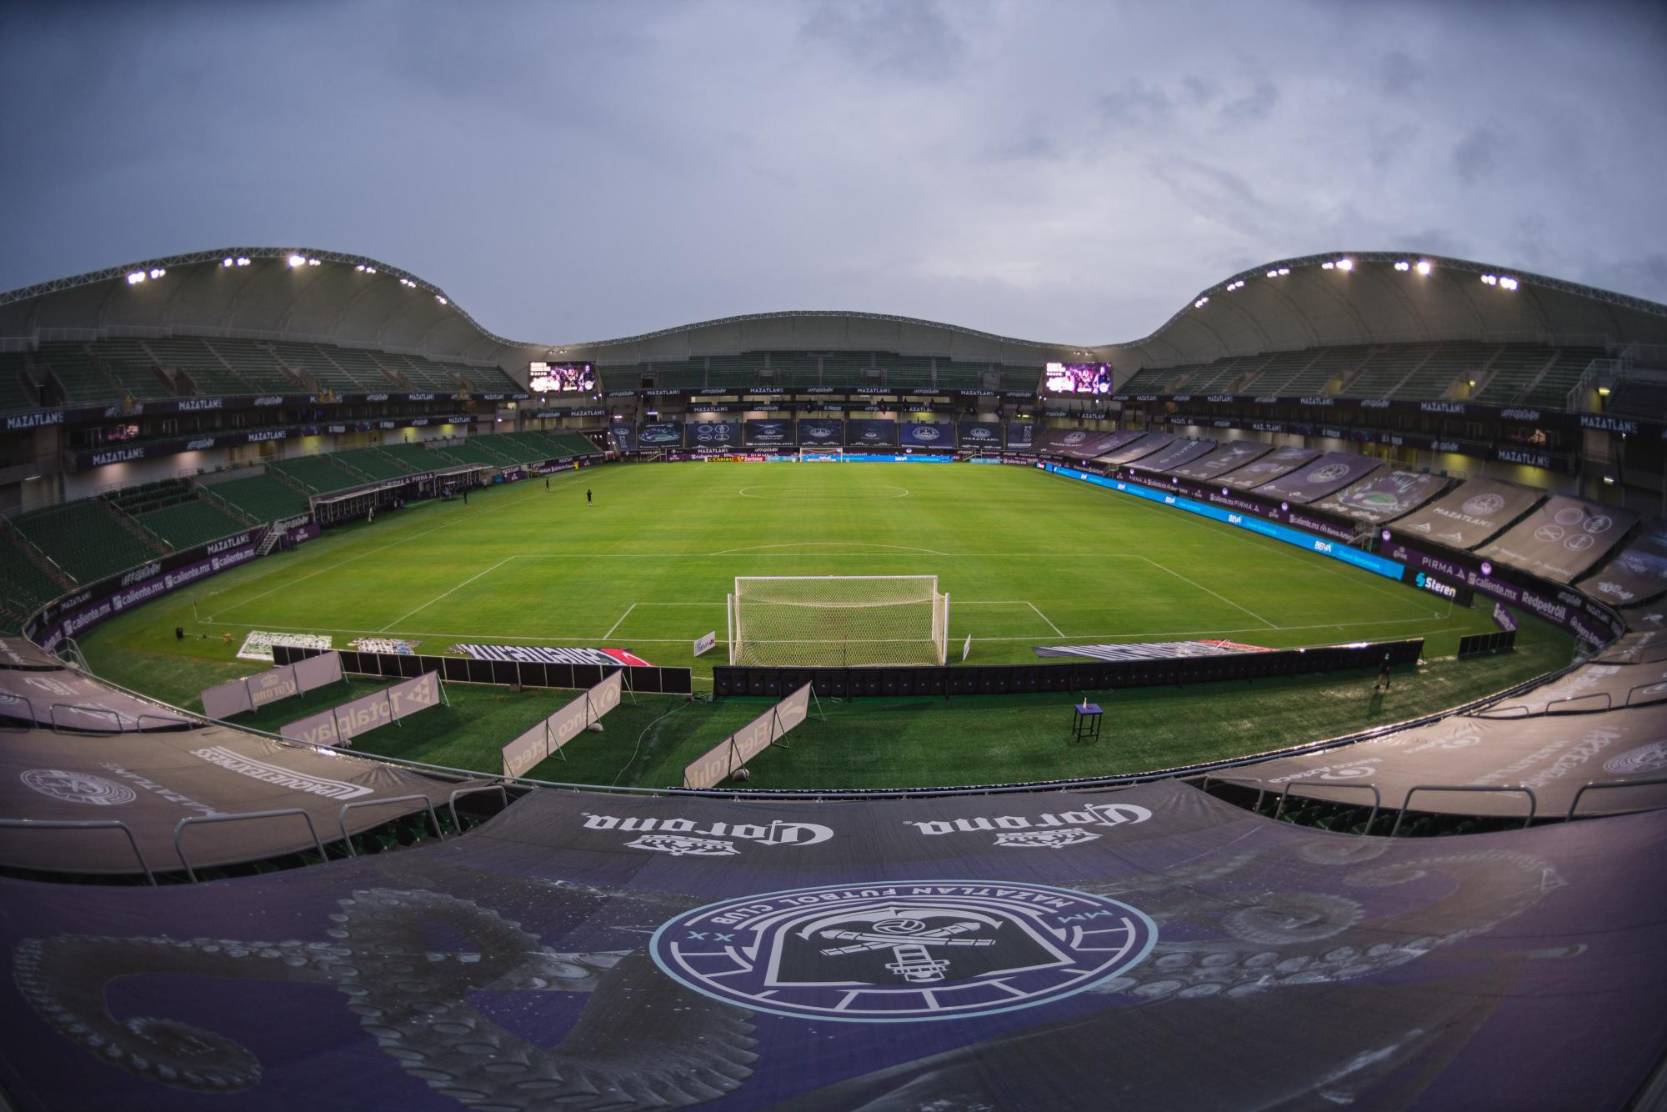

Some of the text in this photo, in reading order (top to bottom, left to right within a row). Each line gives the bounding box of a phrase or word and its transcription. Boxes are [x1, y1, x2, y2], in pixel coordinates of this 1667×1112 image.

[1422, 556, 1453, 575] PIRMA
[1425, 576, 1456, 598] Steren
[582, 814, 835, 846] Corona
[912, 803, 1152, 835] Corona
[710, 887, 1075, 925] MAZATLAN FUTBOL CLUB
